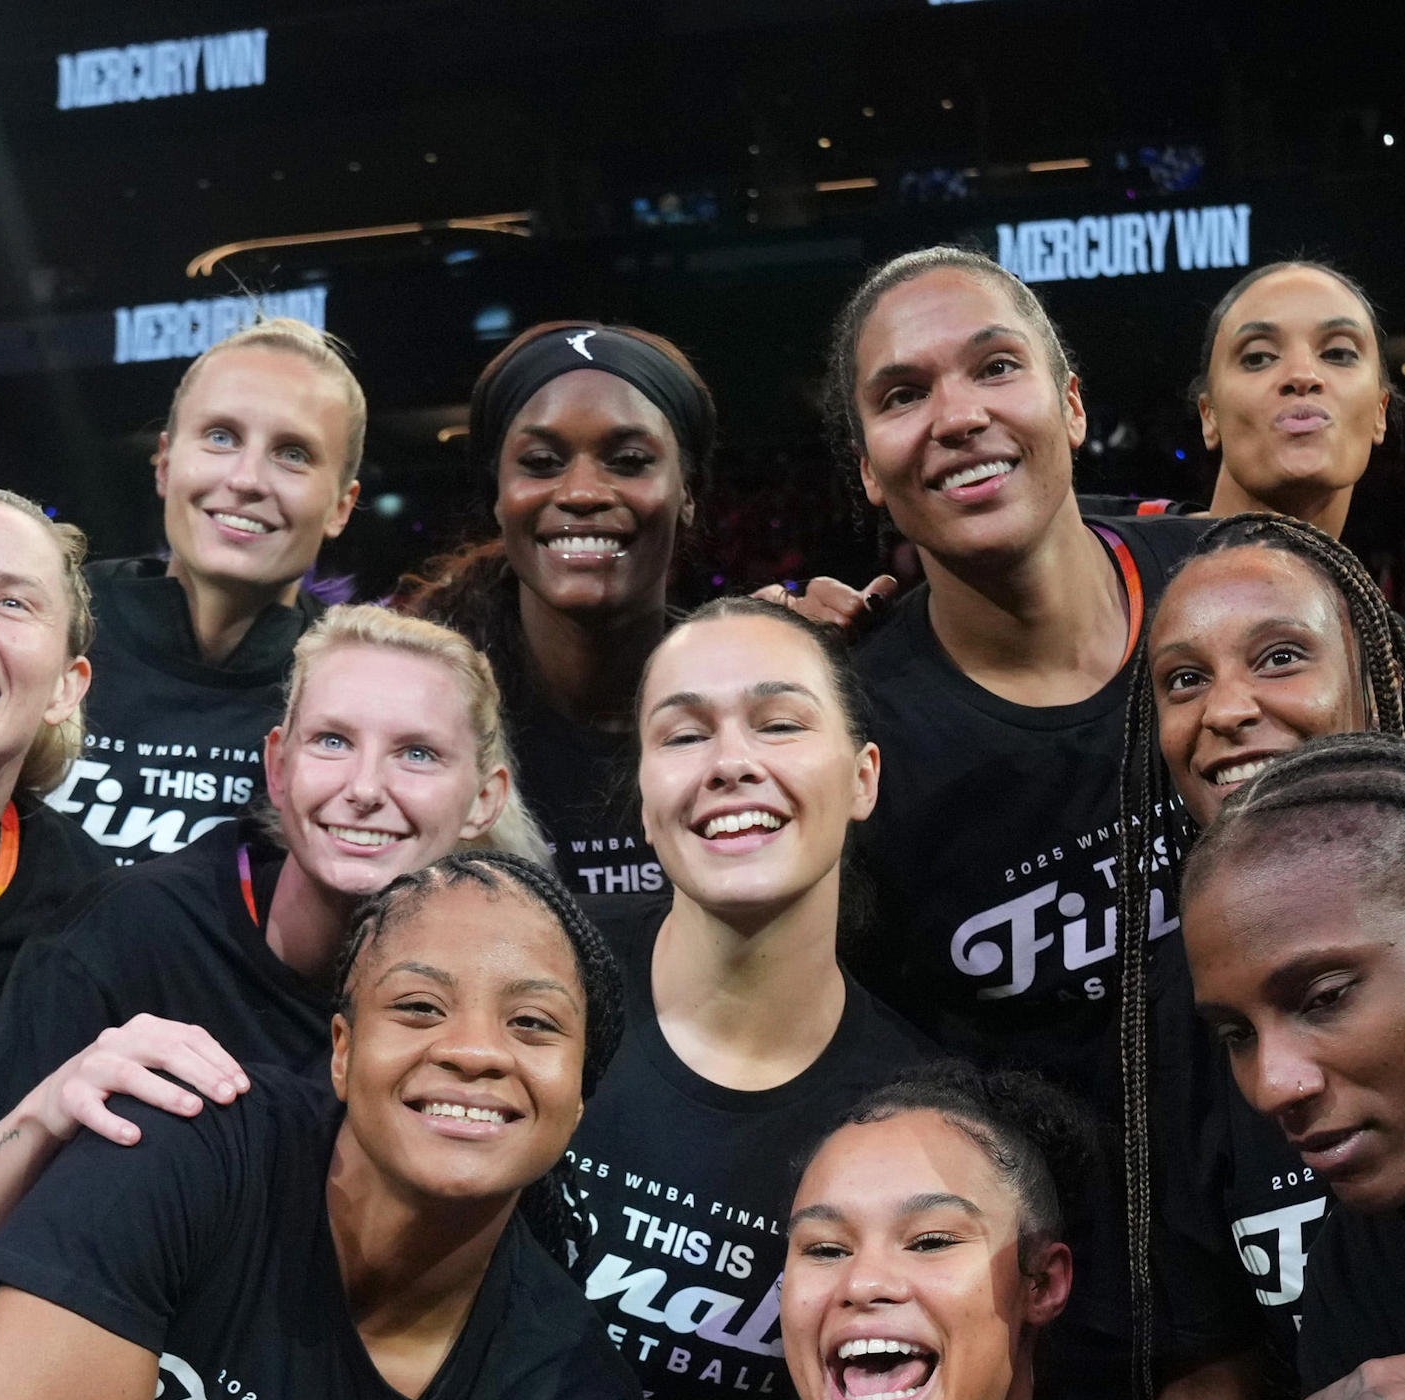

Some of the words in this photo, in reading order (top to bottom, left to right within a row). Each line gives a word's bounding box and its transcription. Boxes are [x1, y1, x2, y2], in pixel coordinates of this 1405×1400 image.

[57, 37, 201, 110] MERCURY
[202, 28, 267, 91] WIN
[997, 210, 1172, 283] MERCURY
[1173, 203, 1250, 271] WIN
[85, 735, 125, 752] 025
[137, 743, 198, 759] WNBA
[210, 747, 260, 763] FINA
[139, 767, 217, 802] THIS
[222, 775, 254, 805] IS
[571, 837, 635, 853] WNBA
[578, 862, 663, 894] THIS
[1005, 847, 1064, 882] 2025
[566, 1150, 610, 1179] 025
[625, 1172, 696, 1208] WNBA
[710, 1201, 781, 1236] FINAL
[1271, 1167, 1315, 1191] 202
[622, 1206, 712, 1265] THIS
[715, 1241, 755, 1279] IS
[607, 1323, 775, 1394] ETBALL
